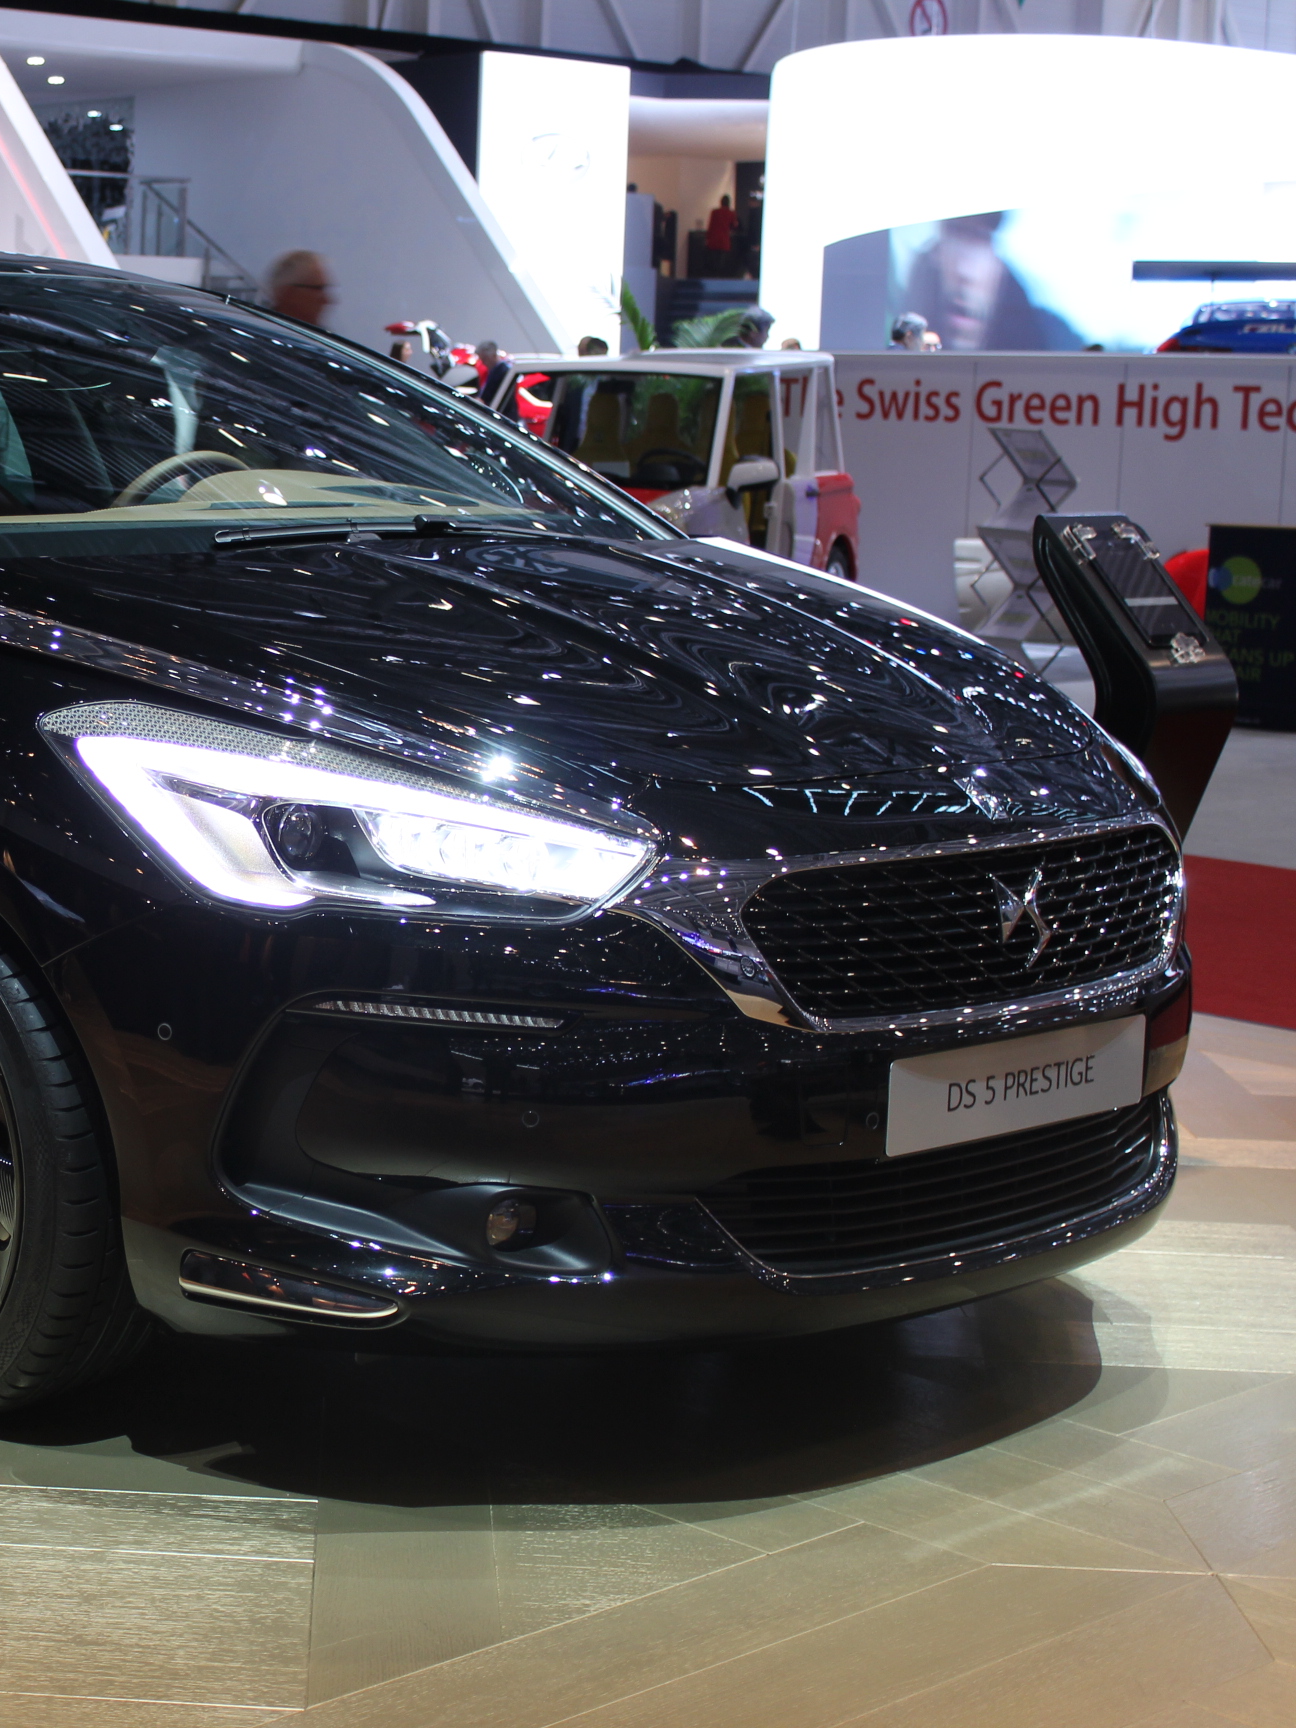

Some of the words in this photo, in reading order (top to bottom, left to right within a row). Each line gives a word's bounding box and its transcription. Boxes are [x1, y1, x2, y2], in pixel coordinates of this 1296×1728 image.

[855, 378, 961, 423] Swiss
[975, 380, 1100, 427] Green
[1115, 381, 1220, 443] High
[947, 1079, 977, 1113] DS
[984, 1075, 996, 1106] 5
[1004, 1055, 1096, 1102] PRESTIGE
